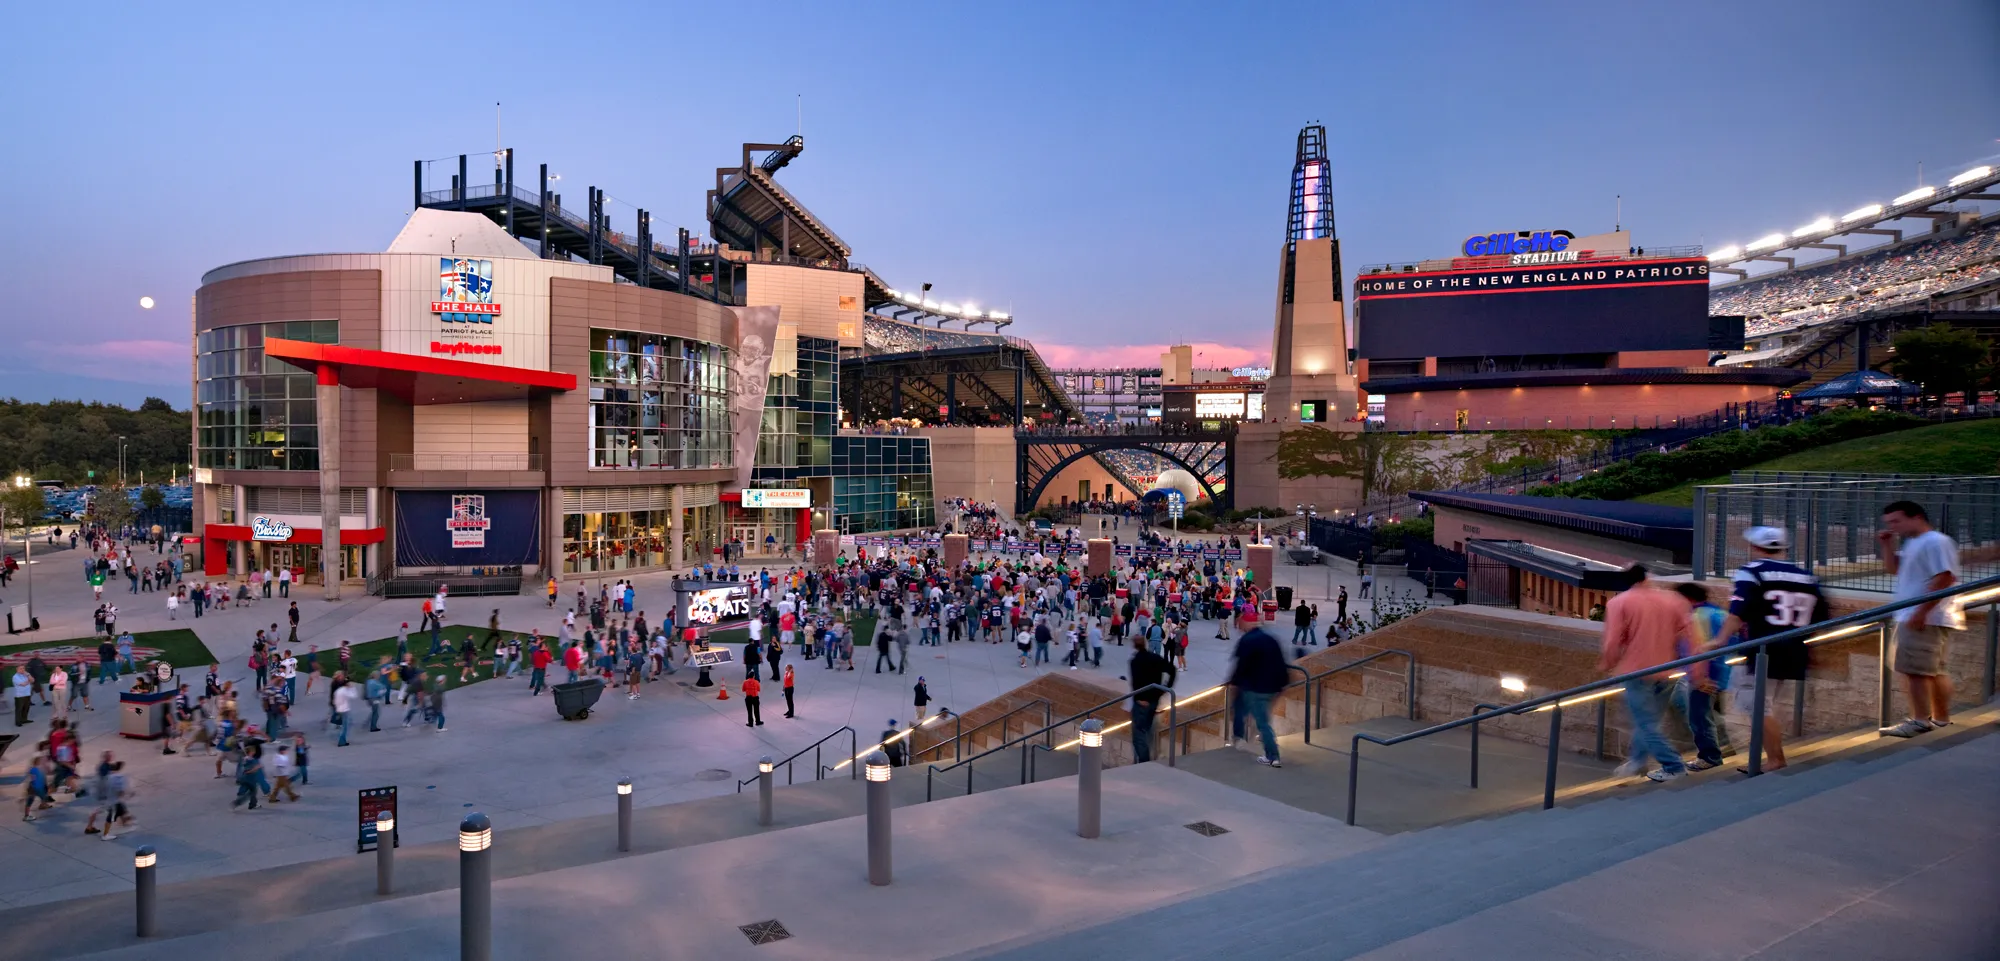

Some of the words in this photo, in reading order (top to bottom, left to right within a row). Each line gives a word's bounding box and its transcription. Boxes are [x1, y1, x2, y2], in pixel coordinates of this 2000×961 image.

[1464, 231, 1570, 257] Gillette
[1512, 250, 1579, 265] STADIUM
[1362, 281, 1406, 292] HOME
[1413, 279, 1433, 289] OF
[1439, 277, 1470, 288] THE
[1478, 275, 1514, 286] NEW
[1522, 270, 1607, 284] ENGLAND
[1615, 265, 1708, 279] PATRIOTS
[433, 303, 459, 311] THE
[464, 303, 499, 312] HALL
[431, 342, 502, 356] Raytheon
[1232, 367, 1271, 377] Gillette
[688, 604, 713, 621] GO
[716, 598, 750, 617] PATS
